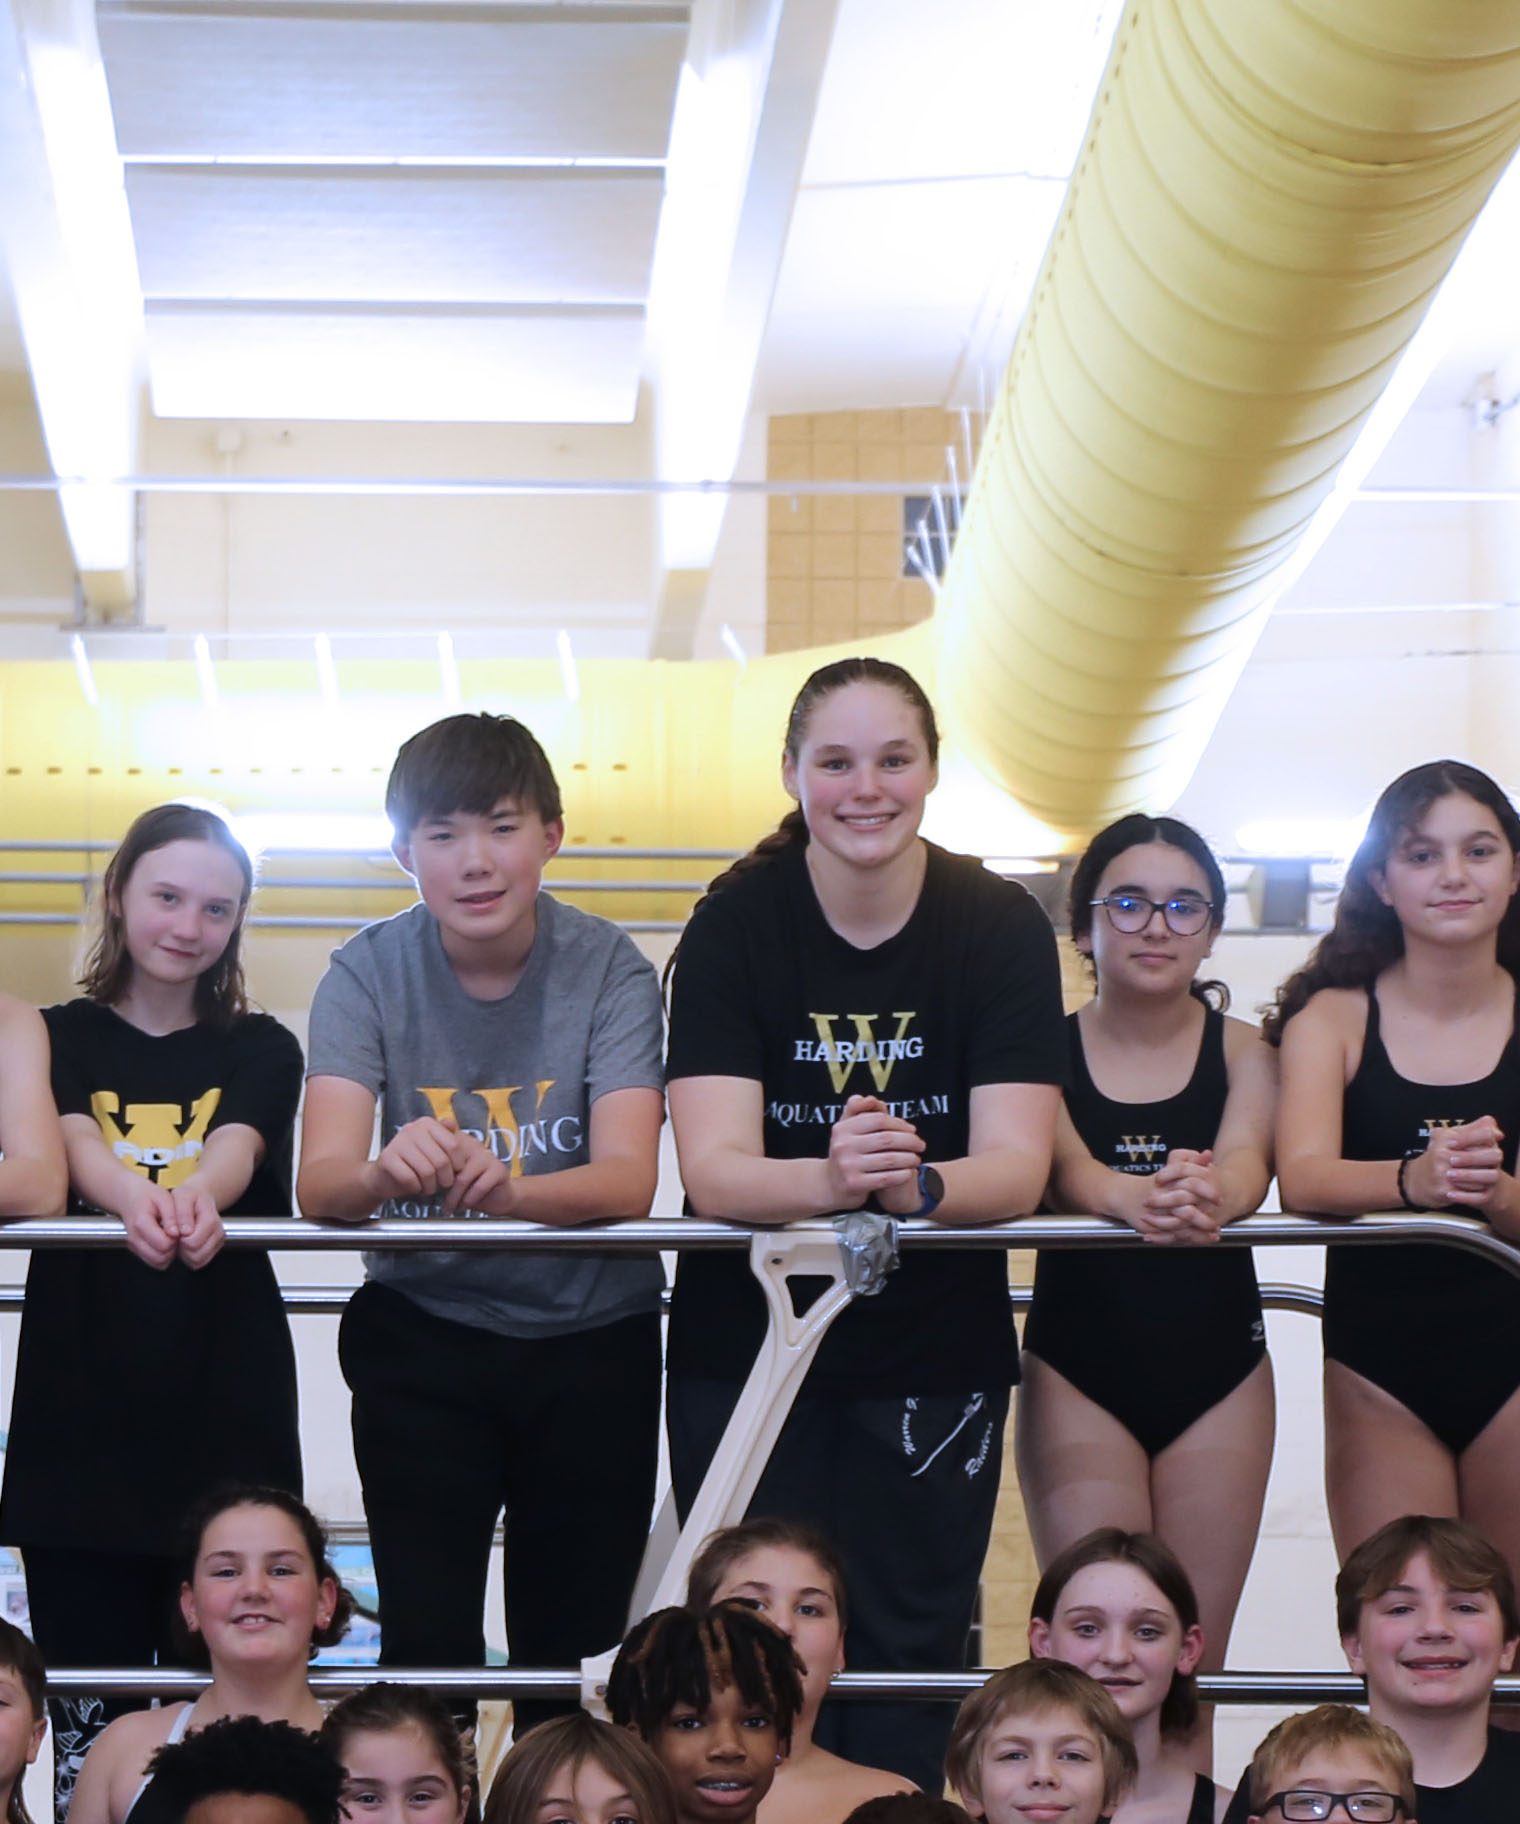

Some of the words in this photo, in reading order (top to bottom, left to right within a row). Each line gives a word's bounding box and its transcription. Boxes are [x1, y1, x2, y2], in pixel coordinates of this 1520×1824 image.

[793, 1036, 925, 1063] HARDING
[808, 1011, 916, 1094] W
[764, 1100, 845, 1128] AQUAT
[886, 1094, 950, 1121] TEAM
